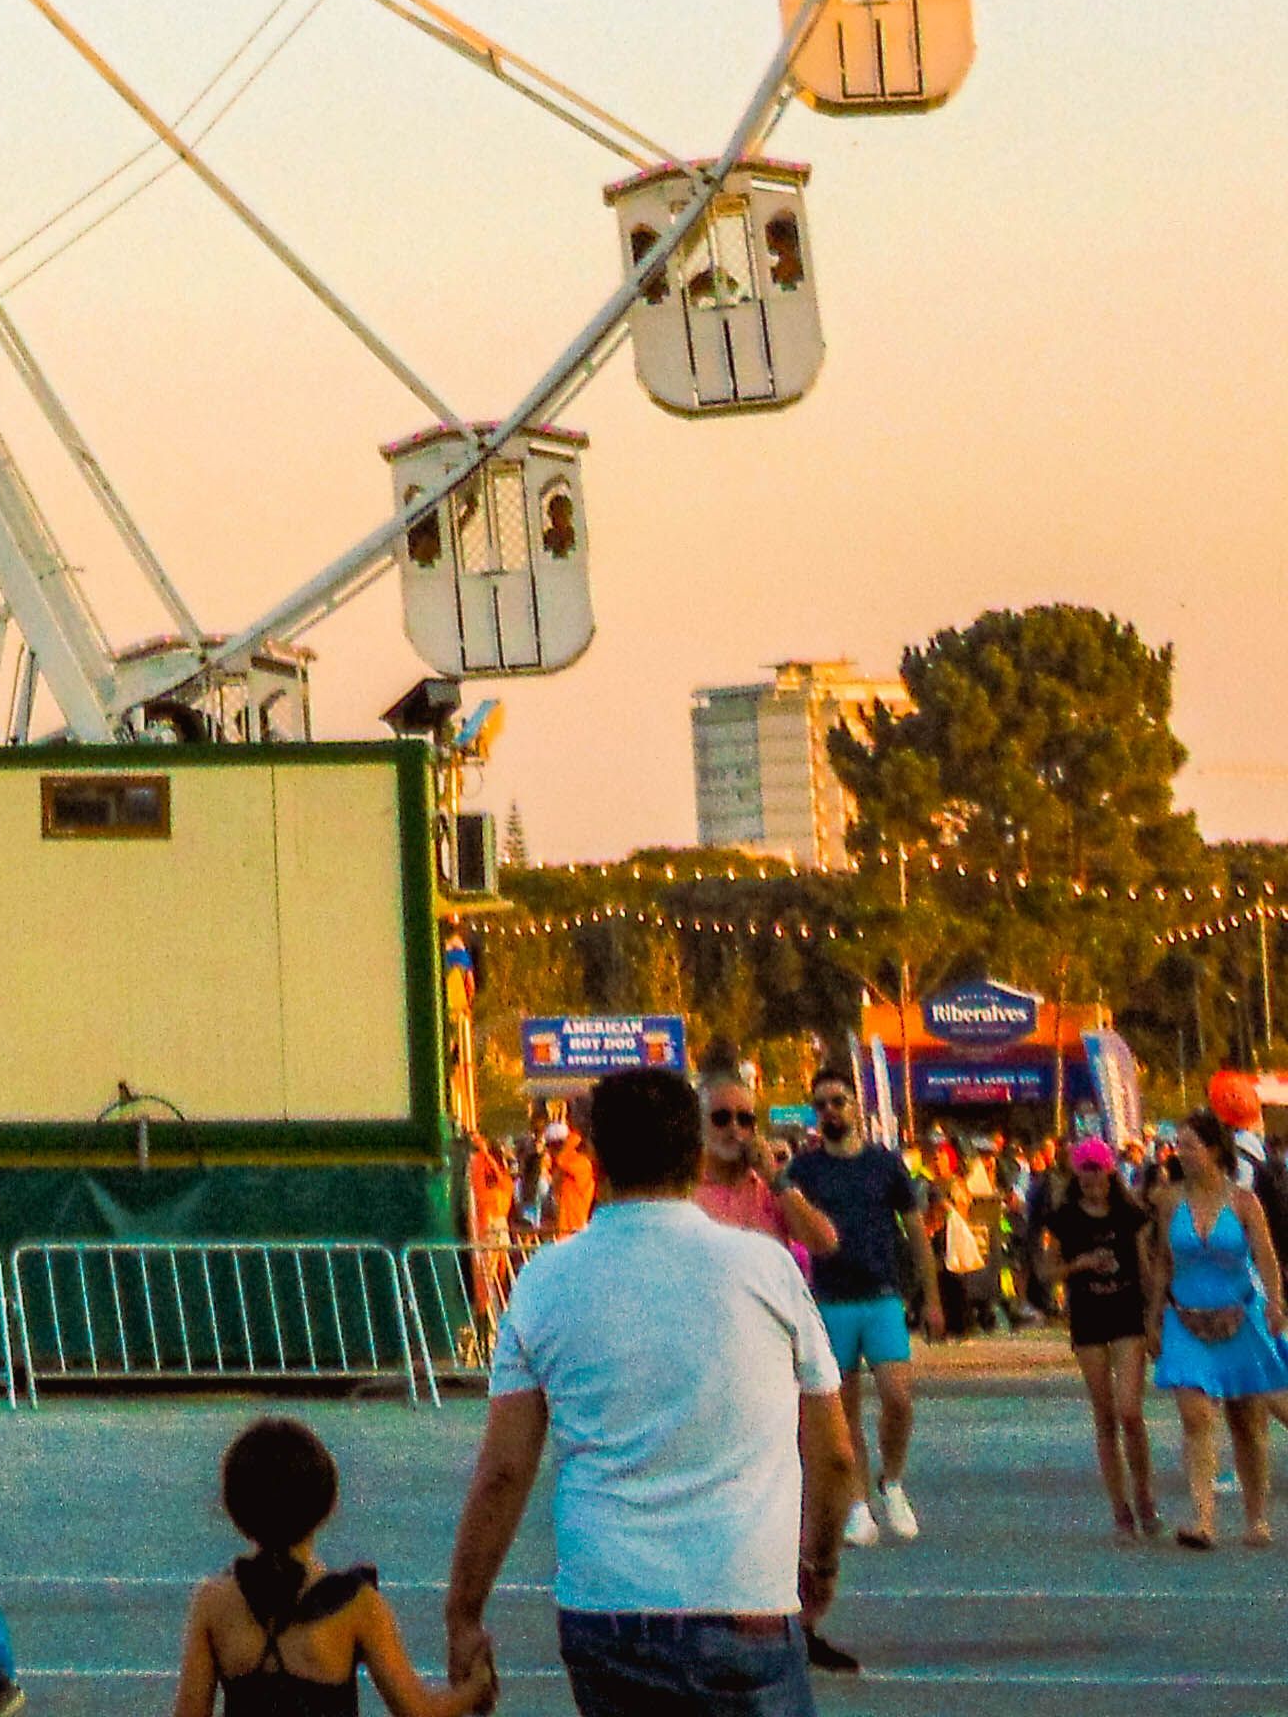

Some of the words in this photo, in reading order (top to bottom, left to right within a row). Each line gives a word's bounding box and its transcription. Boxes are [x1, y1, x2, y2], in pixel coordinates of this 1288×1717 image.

[562, 1020, 643, 1034] AMERICAN
[569, 1037, 601, 1050] HOT
[604, 1037, 636, 1050] DOG
